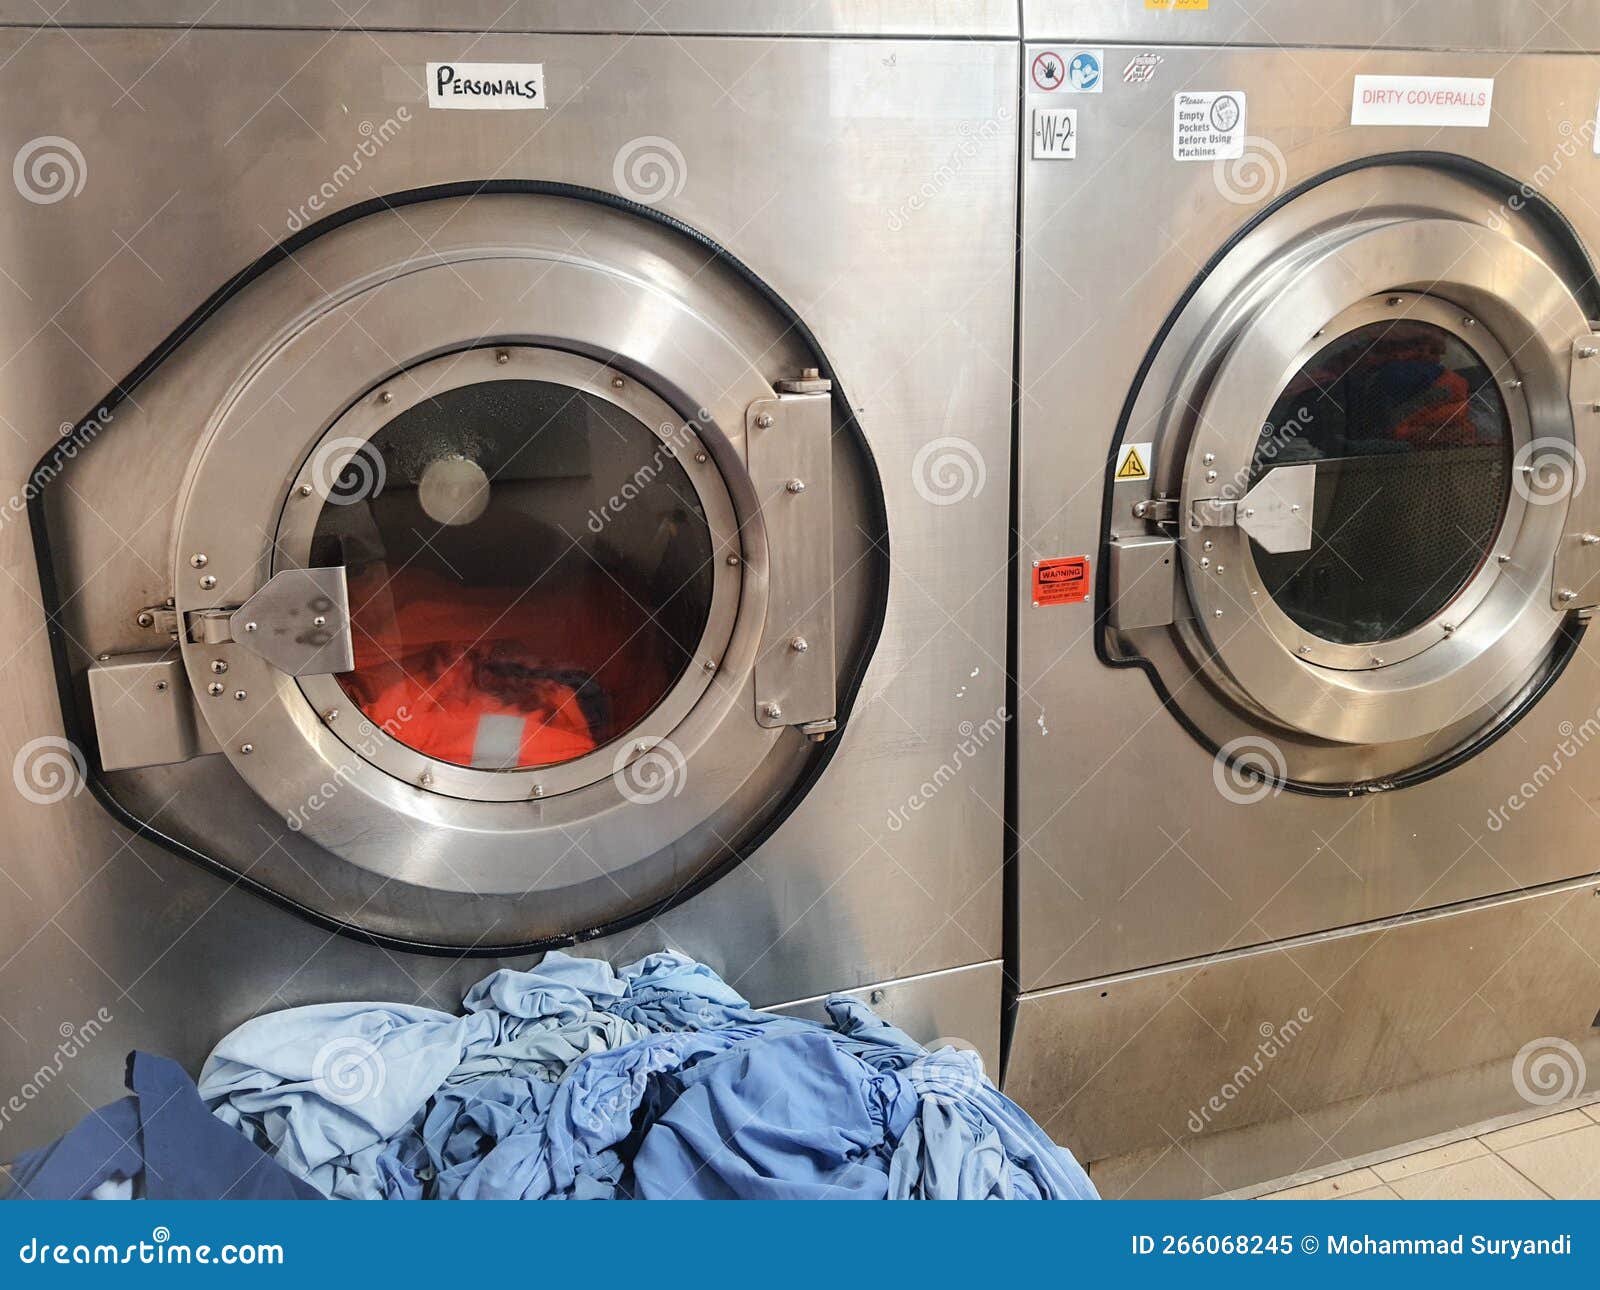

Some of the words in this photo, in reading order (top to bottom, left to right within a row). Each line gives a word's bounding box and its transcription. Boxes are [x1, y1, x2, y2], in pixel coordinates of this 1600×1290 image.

[1362, 90, 1404, 104] DIRTY
[1407, 90, 1486, 106] COVERALLS
[1179, 111, 1204, 121] Empty
[1041, 115, 1071, 151] W-2
[1179, 123, 1210, 132] Pockets
[1179, 136, 1207, 145] Before
[1209, 134, 1232, 144] Using
[1178, 147, 1216, 157] Machines
[1042, 567, 1080, 579] WARNING
